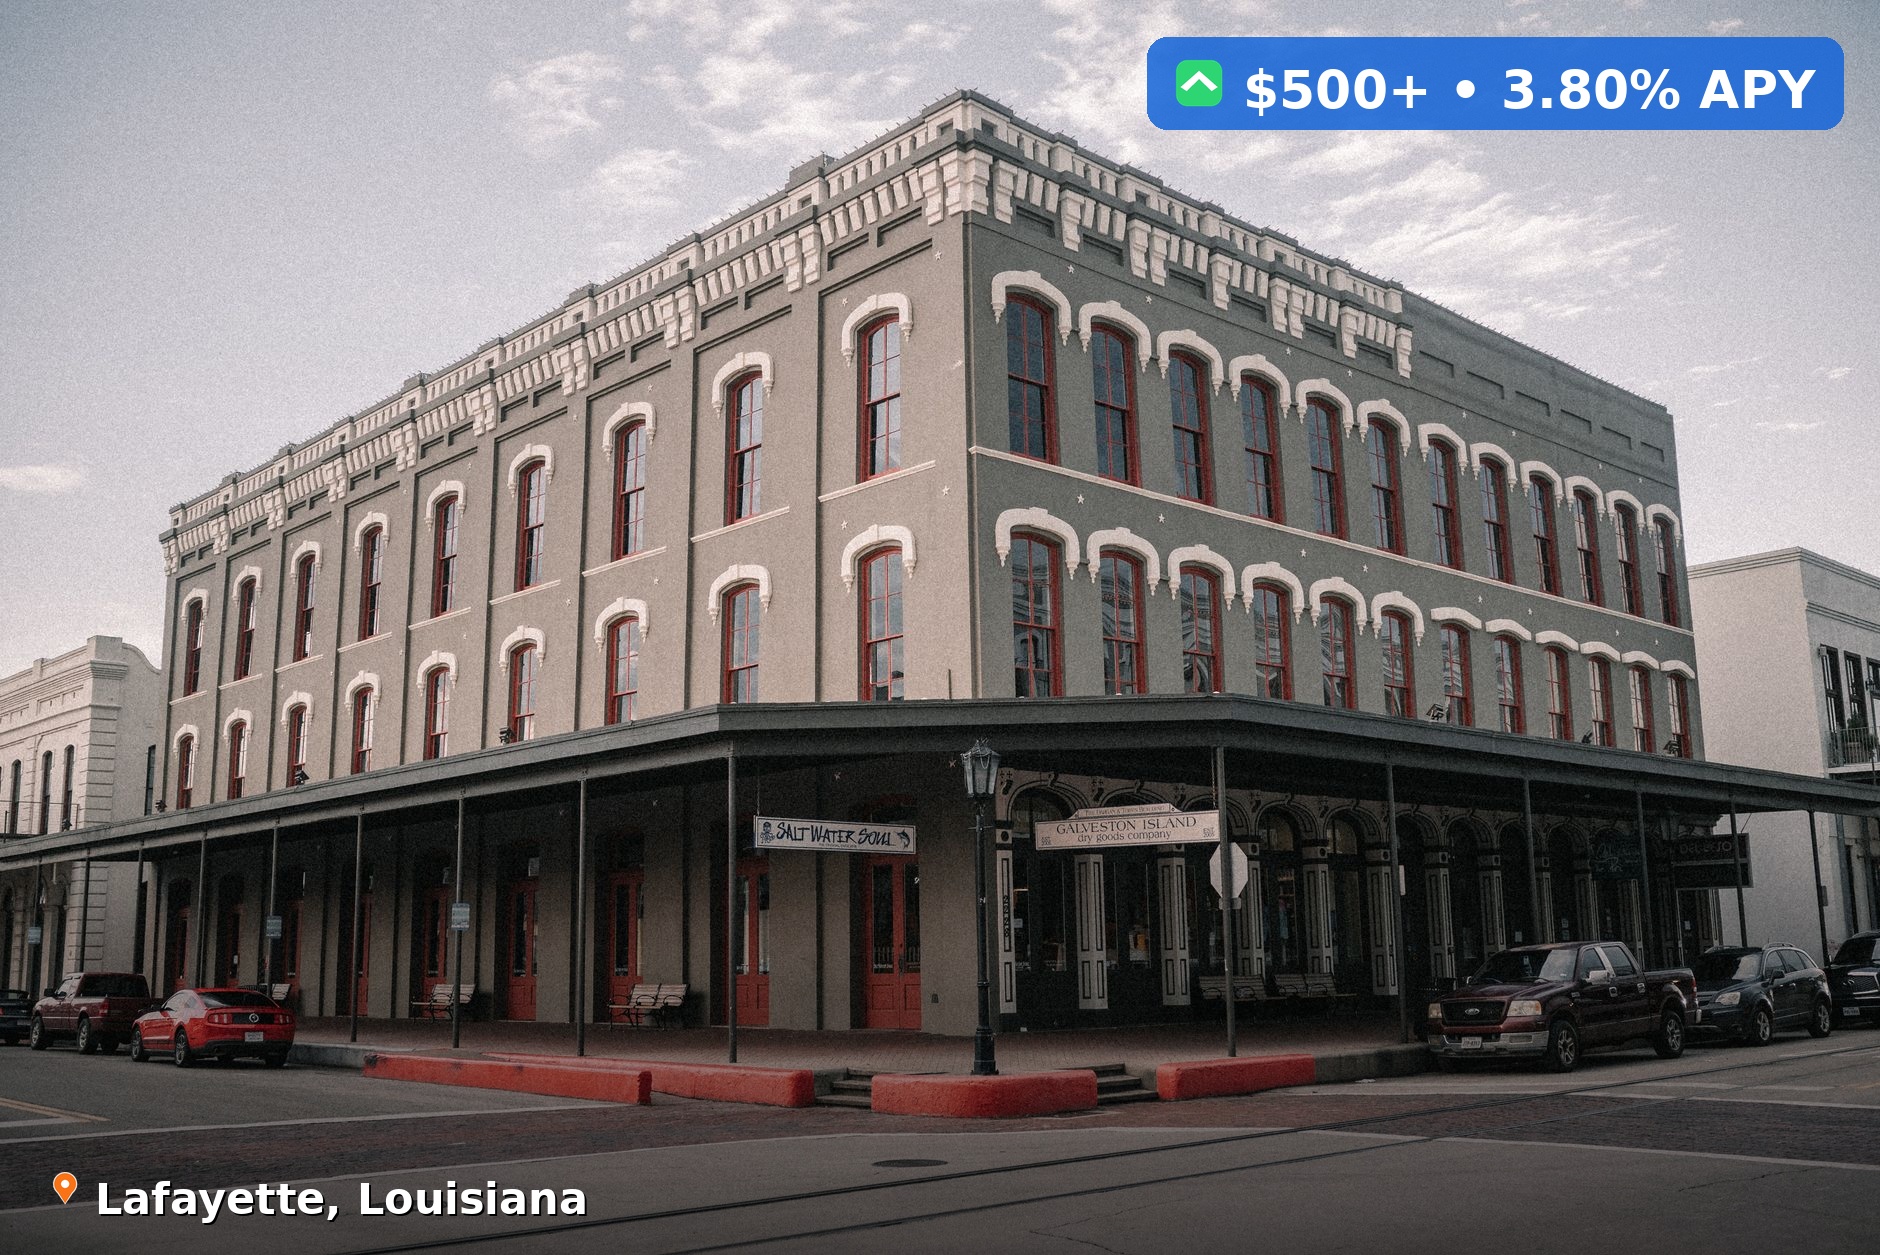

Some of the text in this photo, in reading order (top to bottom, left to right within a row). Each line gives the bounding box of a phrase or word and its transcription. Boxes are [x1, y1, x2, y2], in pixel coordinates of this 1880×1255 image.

[776, 821, 896, 847] SALT WATER SOUL
[1056, 816, 1197, 835] GALVESTON ISLAND
[1077, 828, 1172, 844] dry goods company
